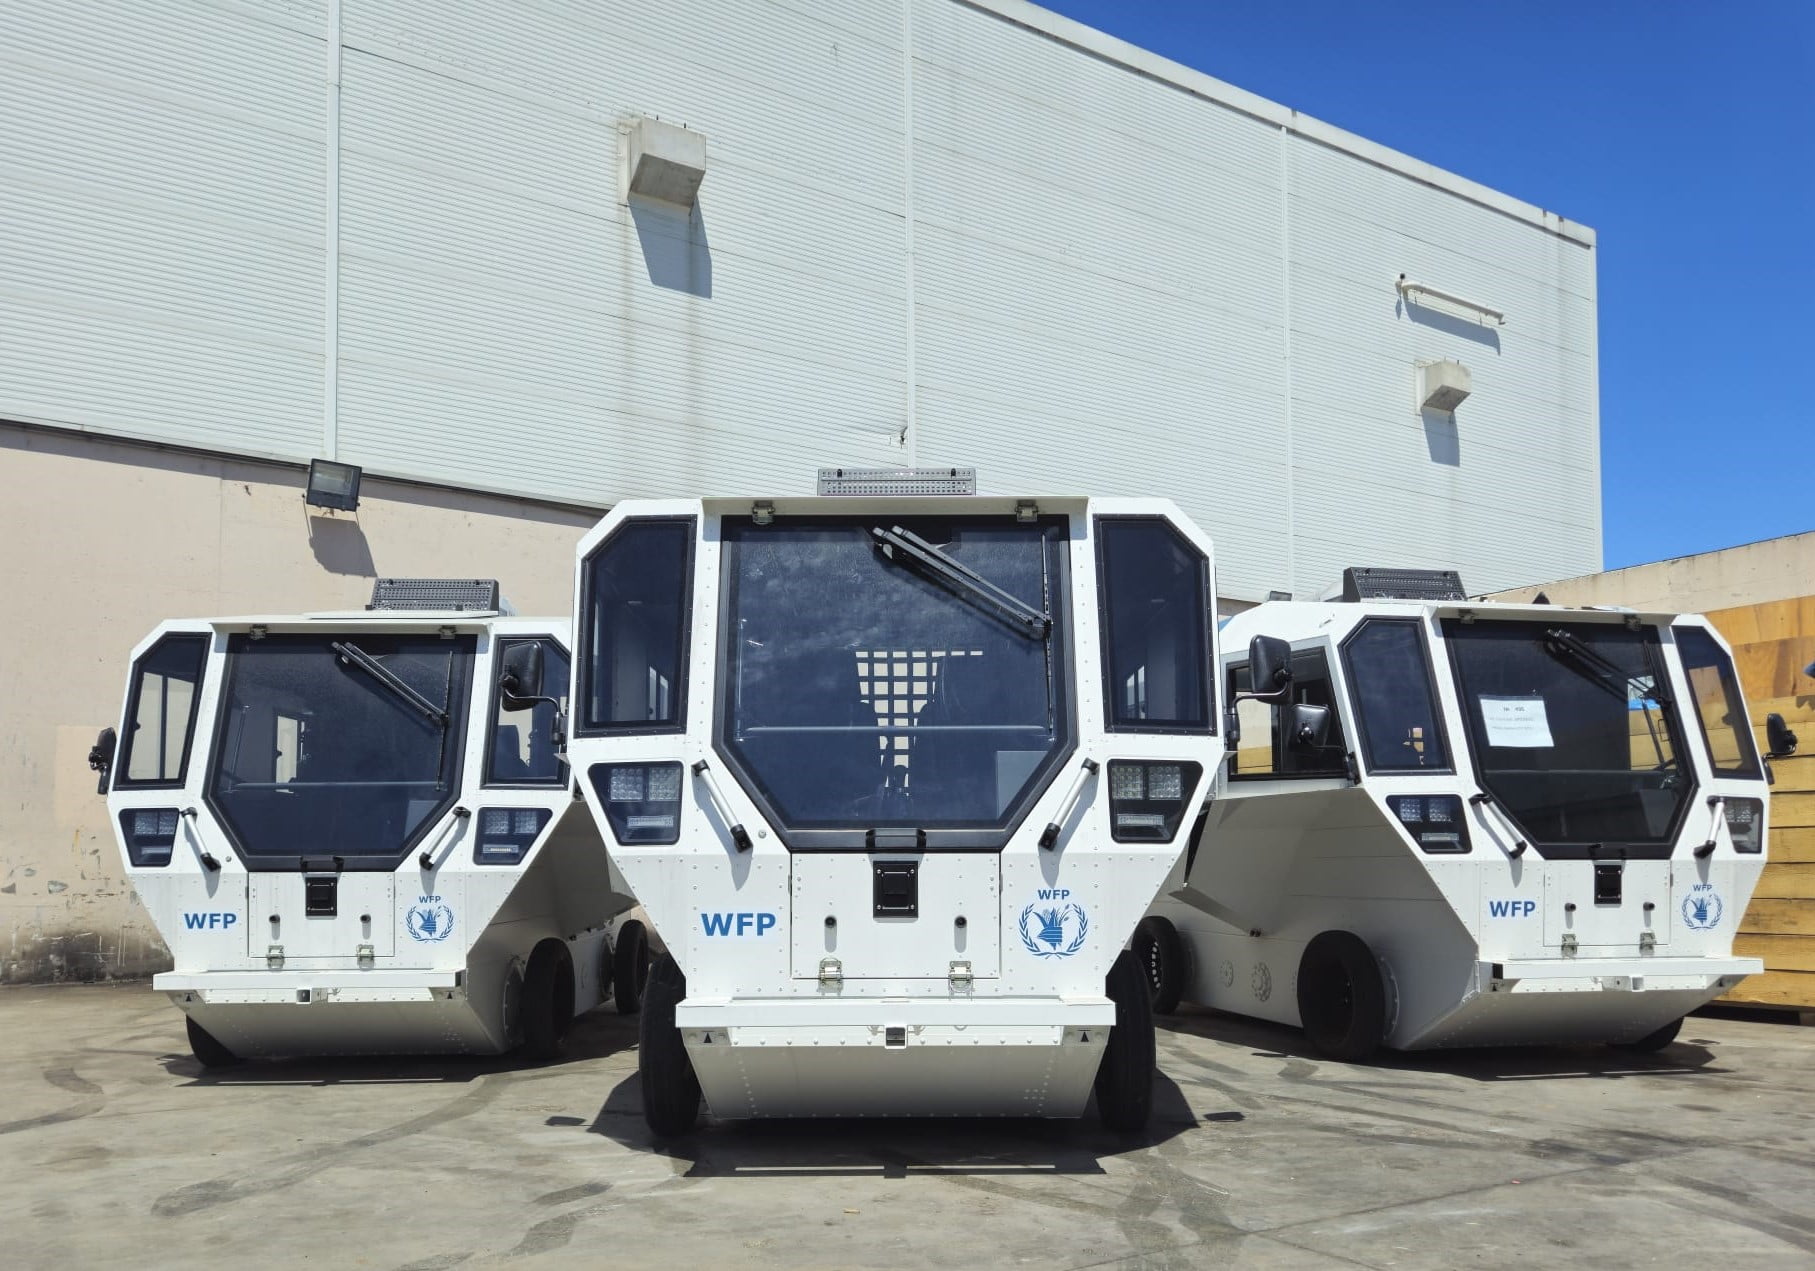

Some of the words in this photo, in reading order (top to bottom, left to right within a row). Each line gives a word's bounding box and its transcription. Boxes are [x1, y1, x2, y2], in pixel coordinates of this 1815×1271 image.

[418, 896, 441, 904] WFP
[1037, 889, 1070, 900] WFP
[1489, 901, 1536, 918] WFP
[184, 913, 237, 930] WFP
[701, 912, 776, 937] WFP
